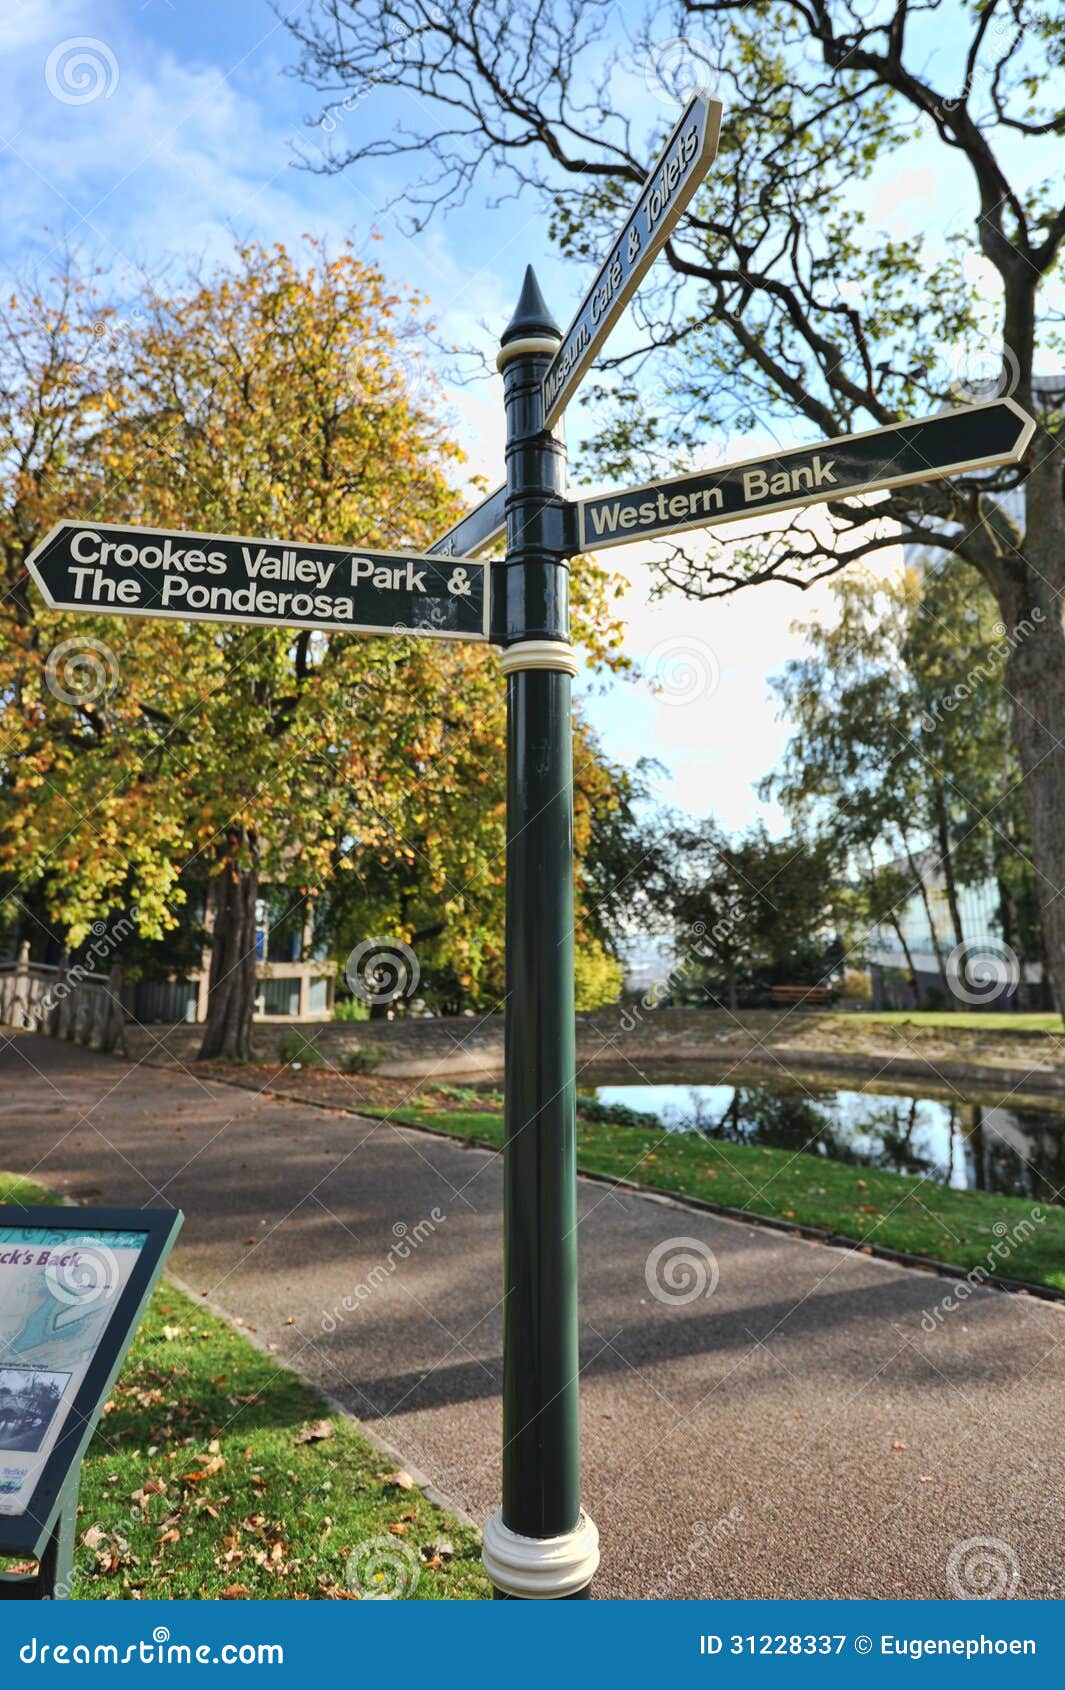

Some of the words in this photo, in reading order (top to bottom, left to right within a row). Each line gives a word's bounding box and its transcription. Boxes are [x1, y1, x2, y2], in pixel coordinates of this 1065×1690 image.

[545, 324, 591, 411] Museum,
[591, 250, 622, 326] Café
[628, 226, 641, 265] &
[643, 125, 698, 234] Toilets
[591, 486, 723, 535] Western
[743, 456, 838, 502] Bank
[68, 566, 142, 603] The
[161, 574, 354, 620] Ponderosa
[70, 531, 228, 575] Crookes
[242, 547, 335, 589] Valley
[351, 557, 427, 592] Park
[447, 567, 471, 596] &
[0, 1250, 34, 1266] ck's
[36, 1251, 82, 1268] Back
